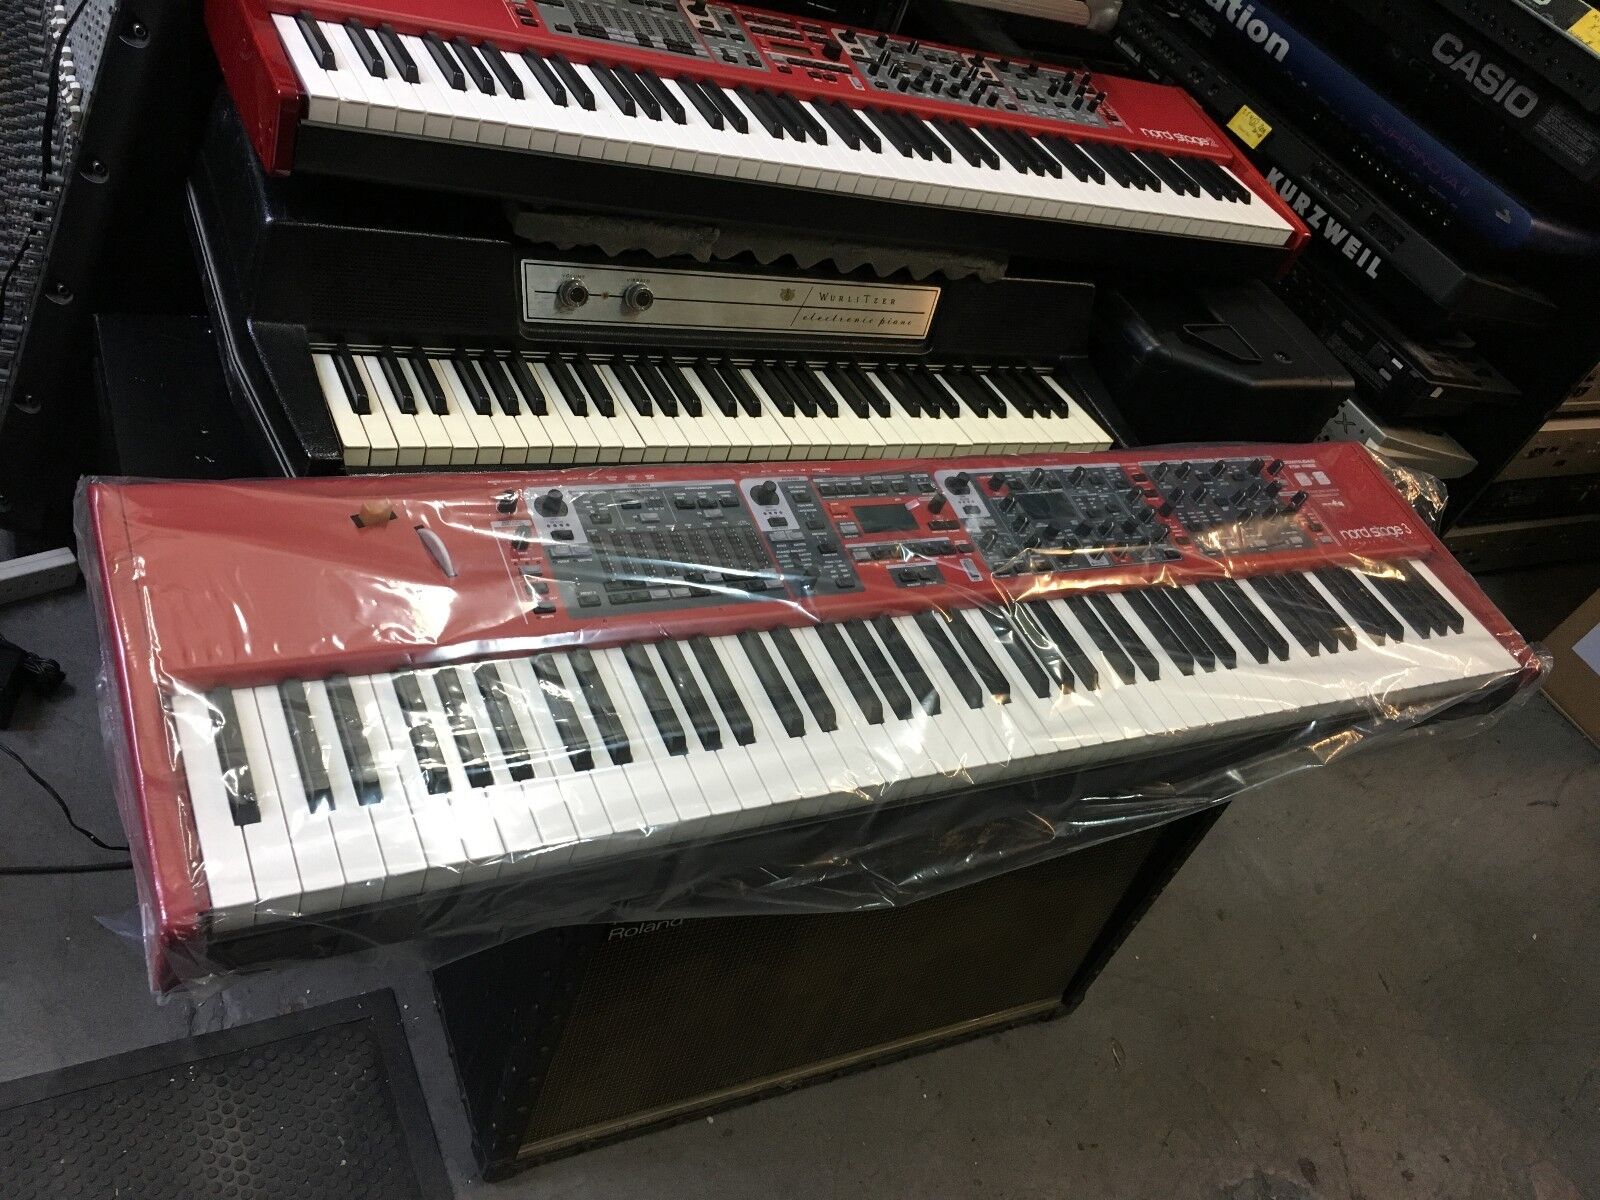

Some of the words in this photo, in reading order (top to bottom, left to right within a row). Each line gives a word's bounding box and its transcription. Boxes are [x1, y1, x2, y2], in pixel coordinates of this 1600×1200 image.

[1431, 32, 1539, 119] CASIO
[1139, 127, 1175, 141] nord
[1173, 132, 1210, 147] stage
[1265, 166, 1382, 280] KURZWEIL
[802, 312, 874, 324] electronic
[877, 316, 912, 328] piano
[1339, 526, 1369, 540] nord
[1369, 525, 1404, 538] stage
[1401, 522, 1412, 535] 3
[607, 918, 684, 941] Roland
